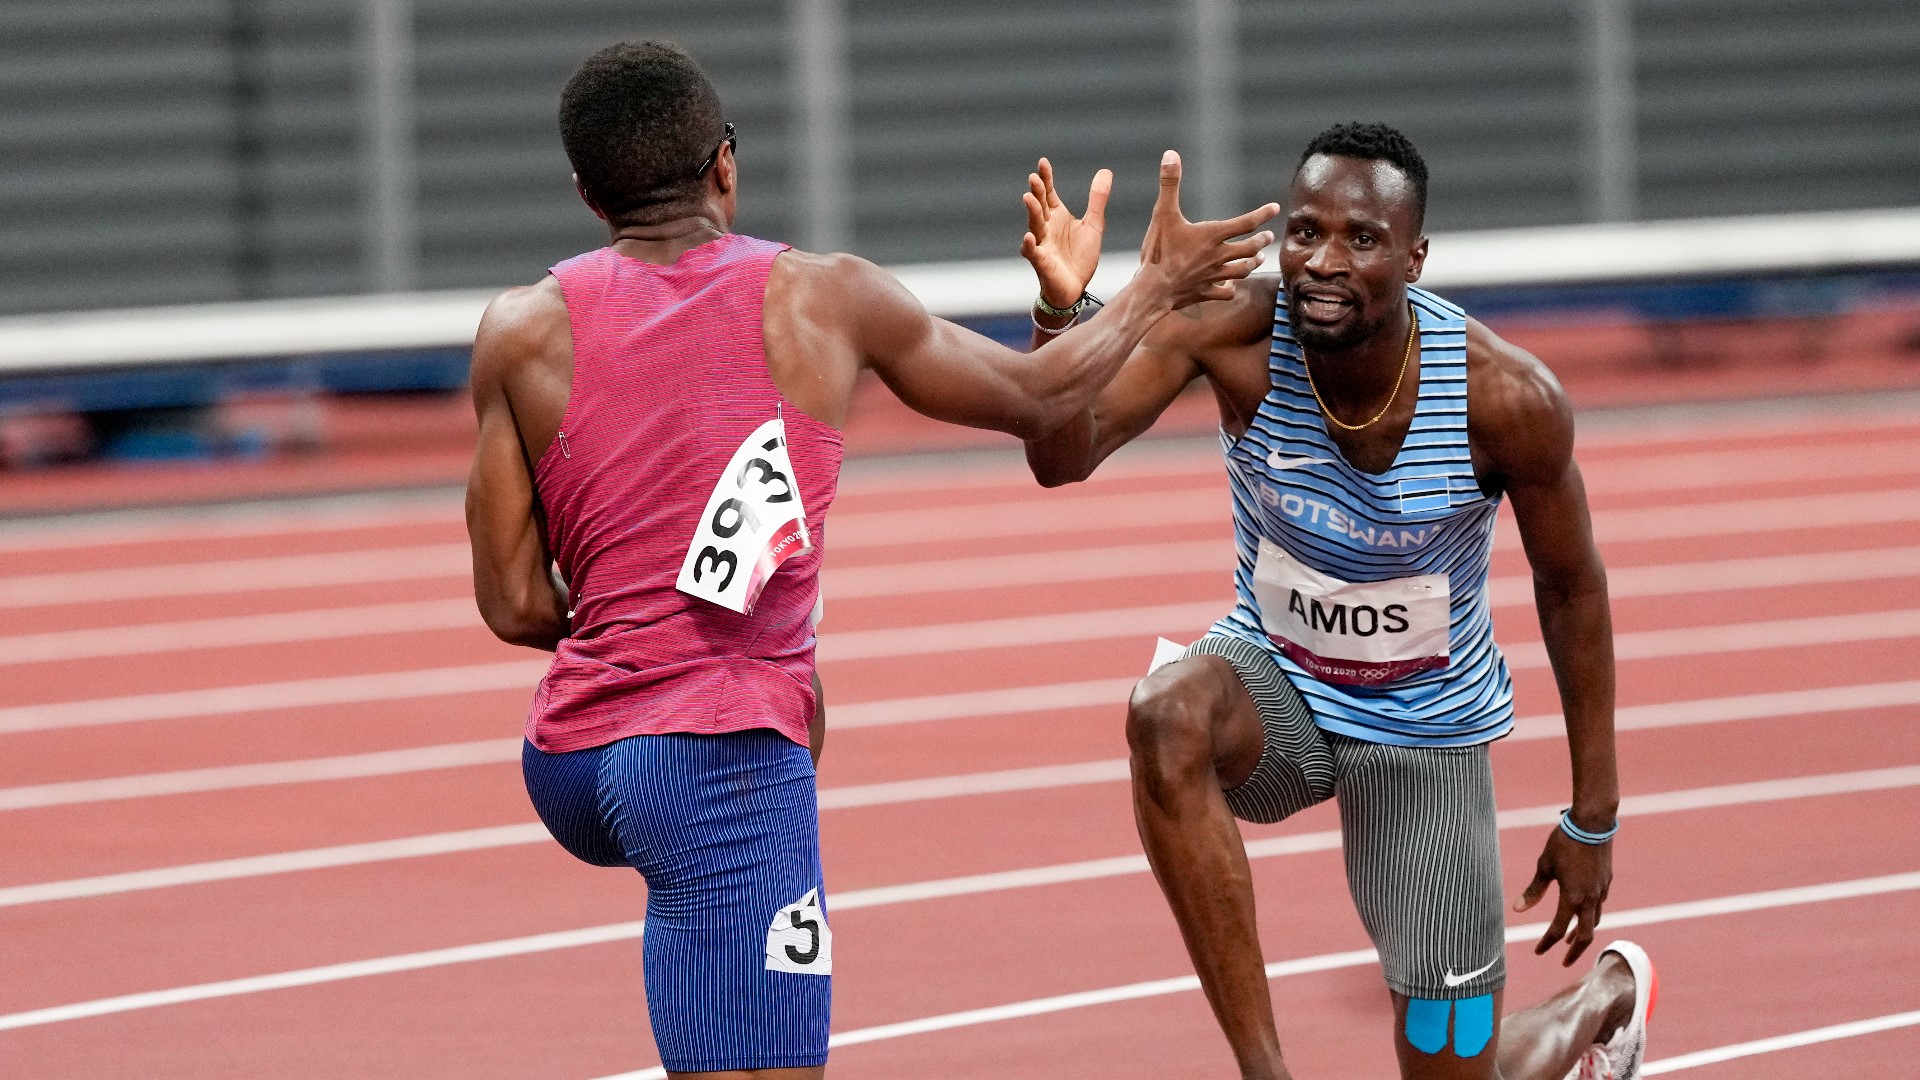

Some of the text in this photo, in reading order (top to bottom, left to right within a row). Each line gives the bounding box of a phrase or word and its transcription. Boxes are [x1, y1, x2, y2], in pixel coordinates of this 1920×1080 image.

[693, 436, 797, 594] 393
[1259, 481, 1441, 548] BOTSWAN
[769, 535, 796, 557] TOKYO
[1288, 588, 1410, 637] AMOS
[1304, 656, 1357, 677] TOKYO 2020
[784, 894, 820, 965] 5
